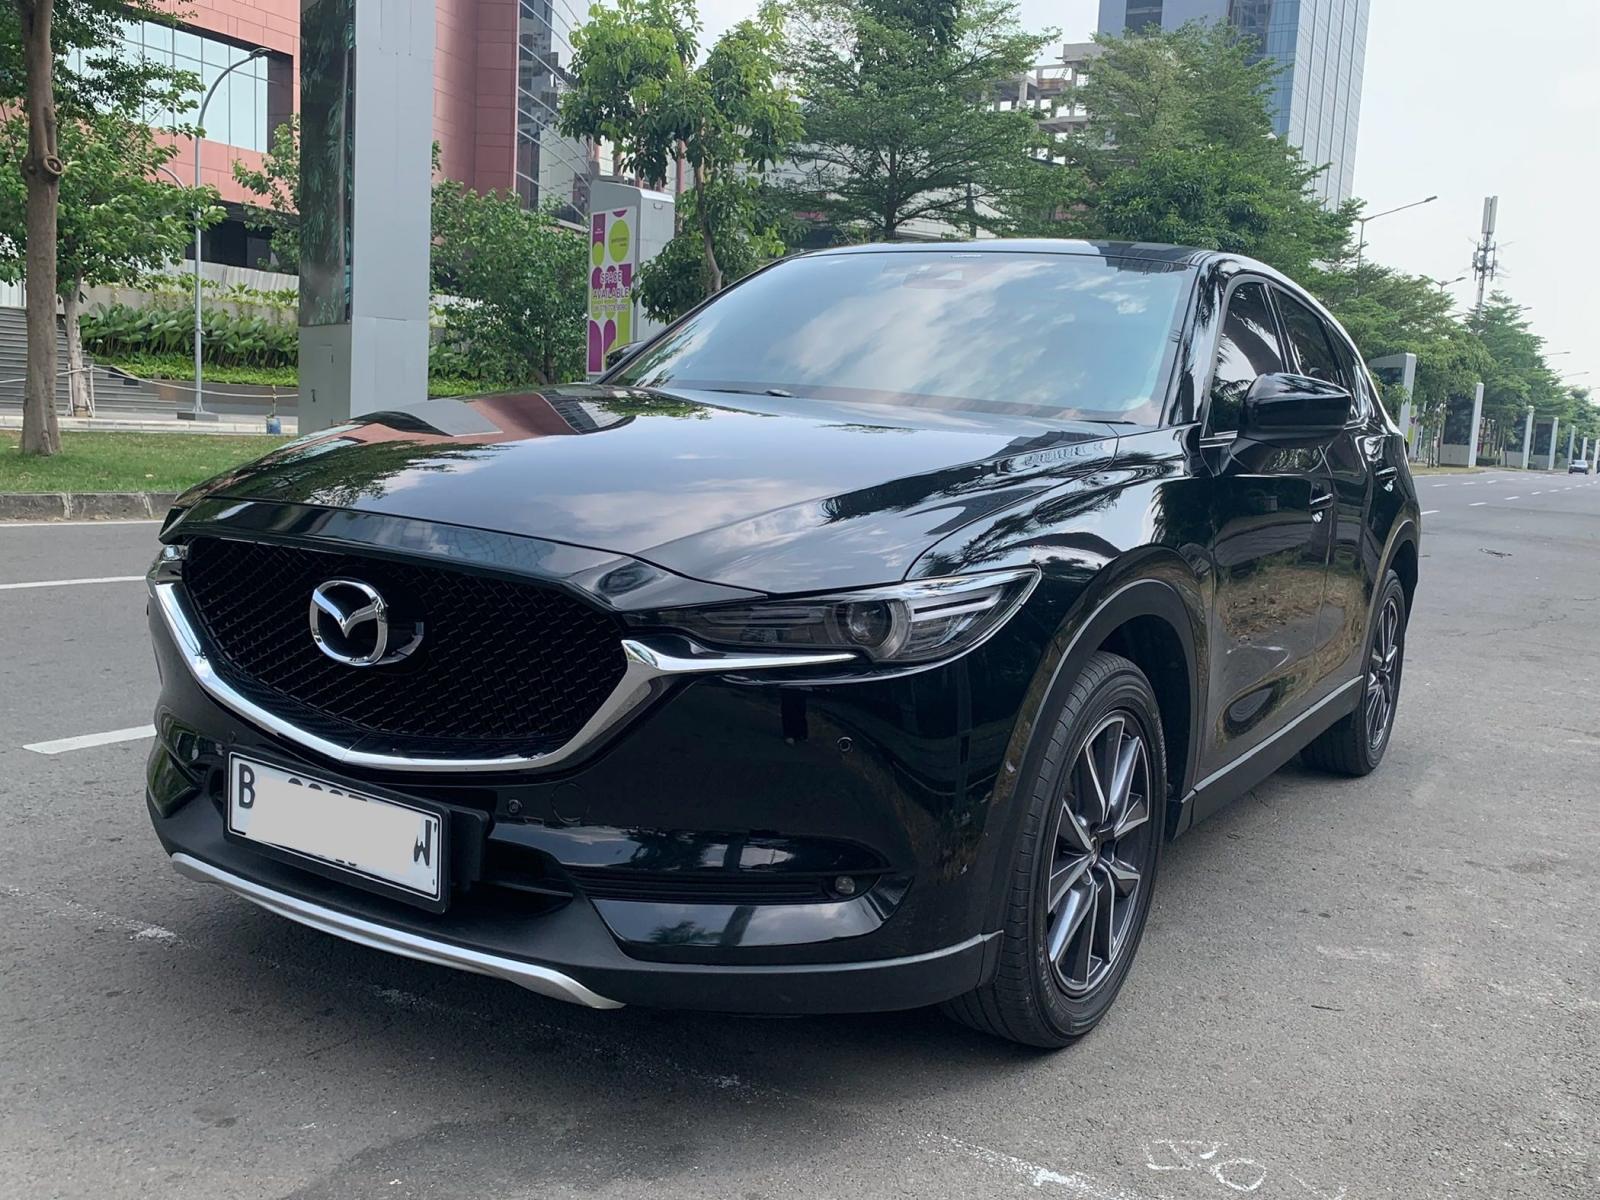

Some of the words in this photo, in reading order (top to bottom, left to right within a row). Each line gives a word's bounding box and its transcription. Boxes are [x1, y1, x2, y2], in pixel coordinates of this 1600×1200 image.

[600, 270, 622, 283] SPACE
[592, 287, 630, 299] AVAILABLE
[238, 763, 256, 809] B
